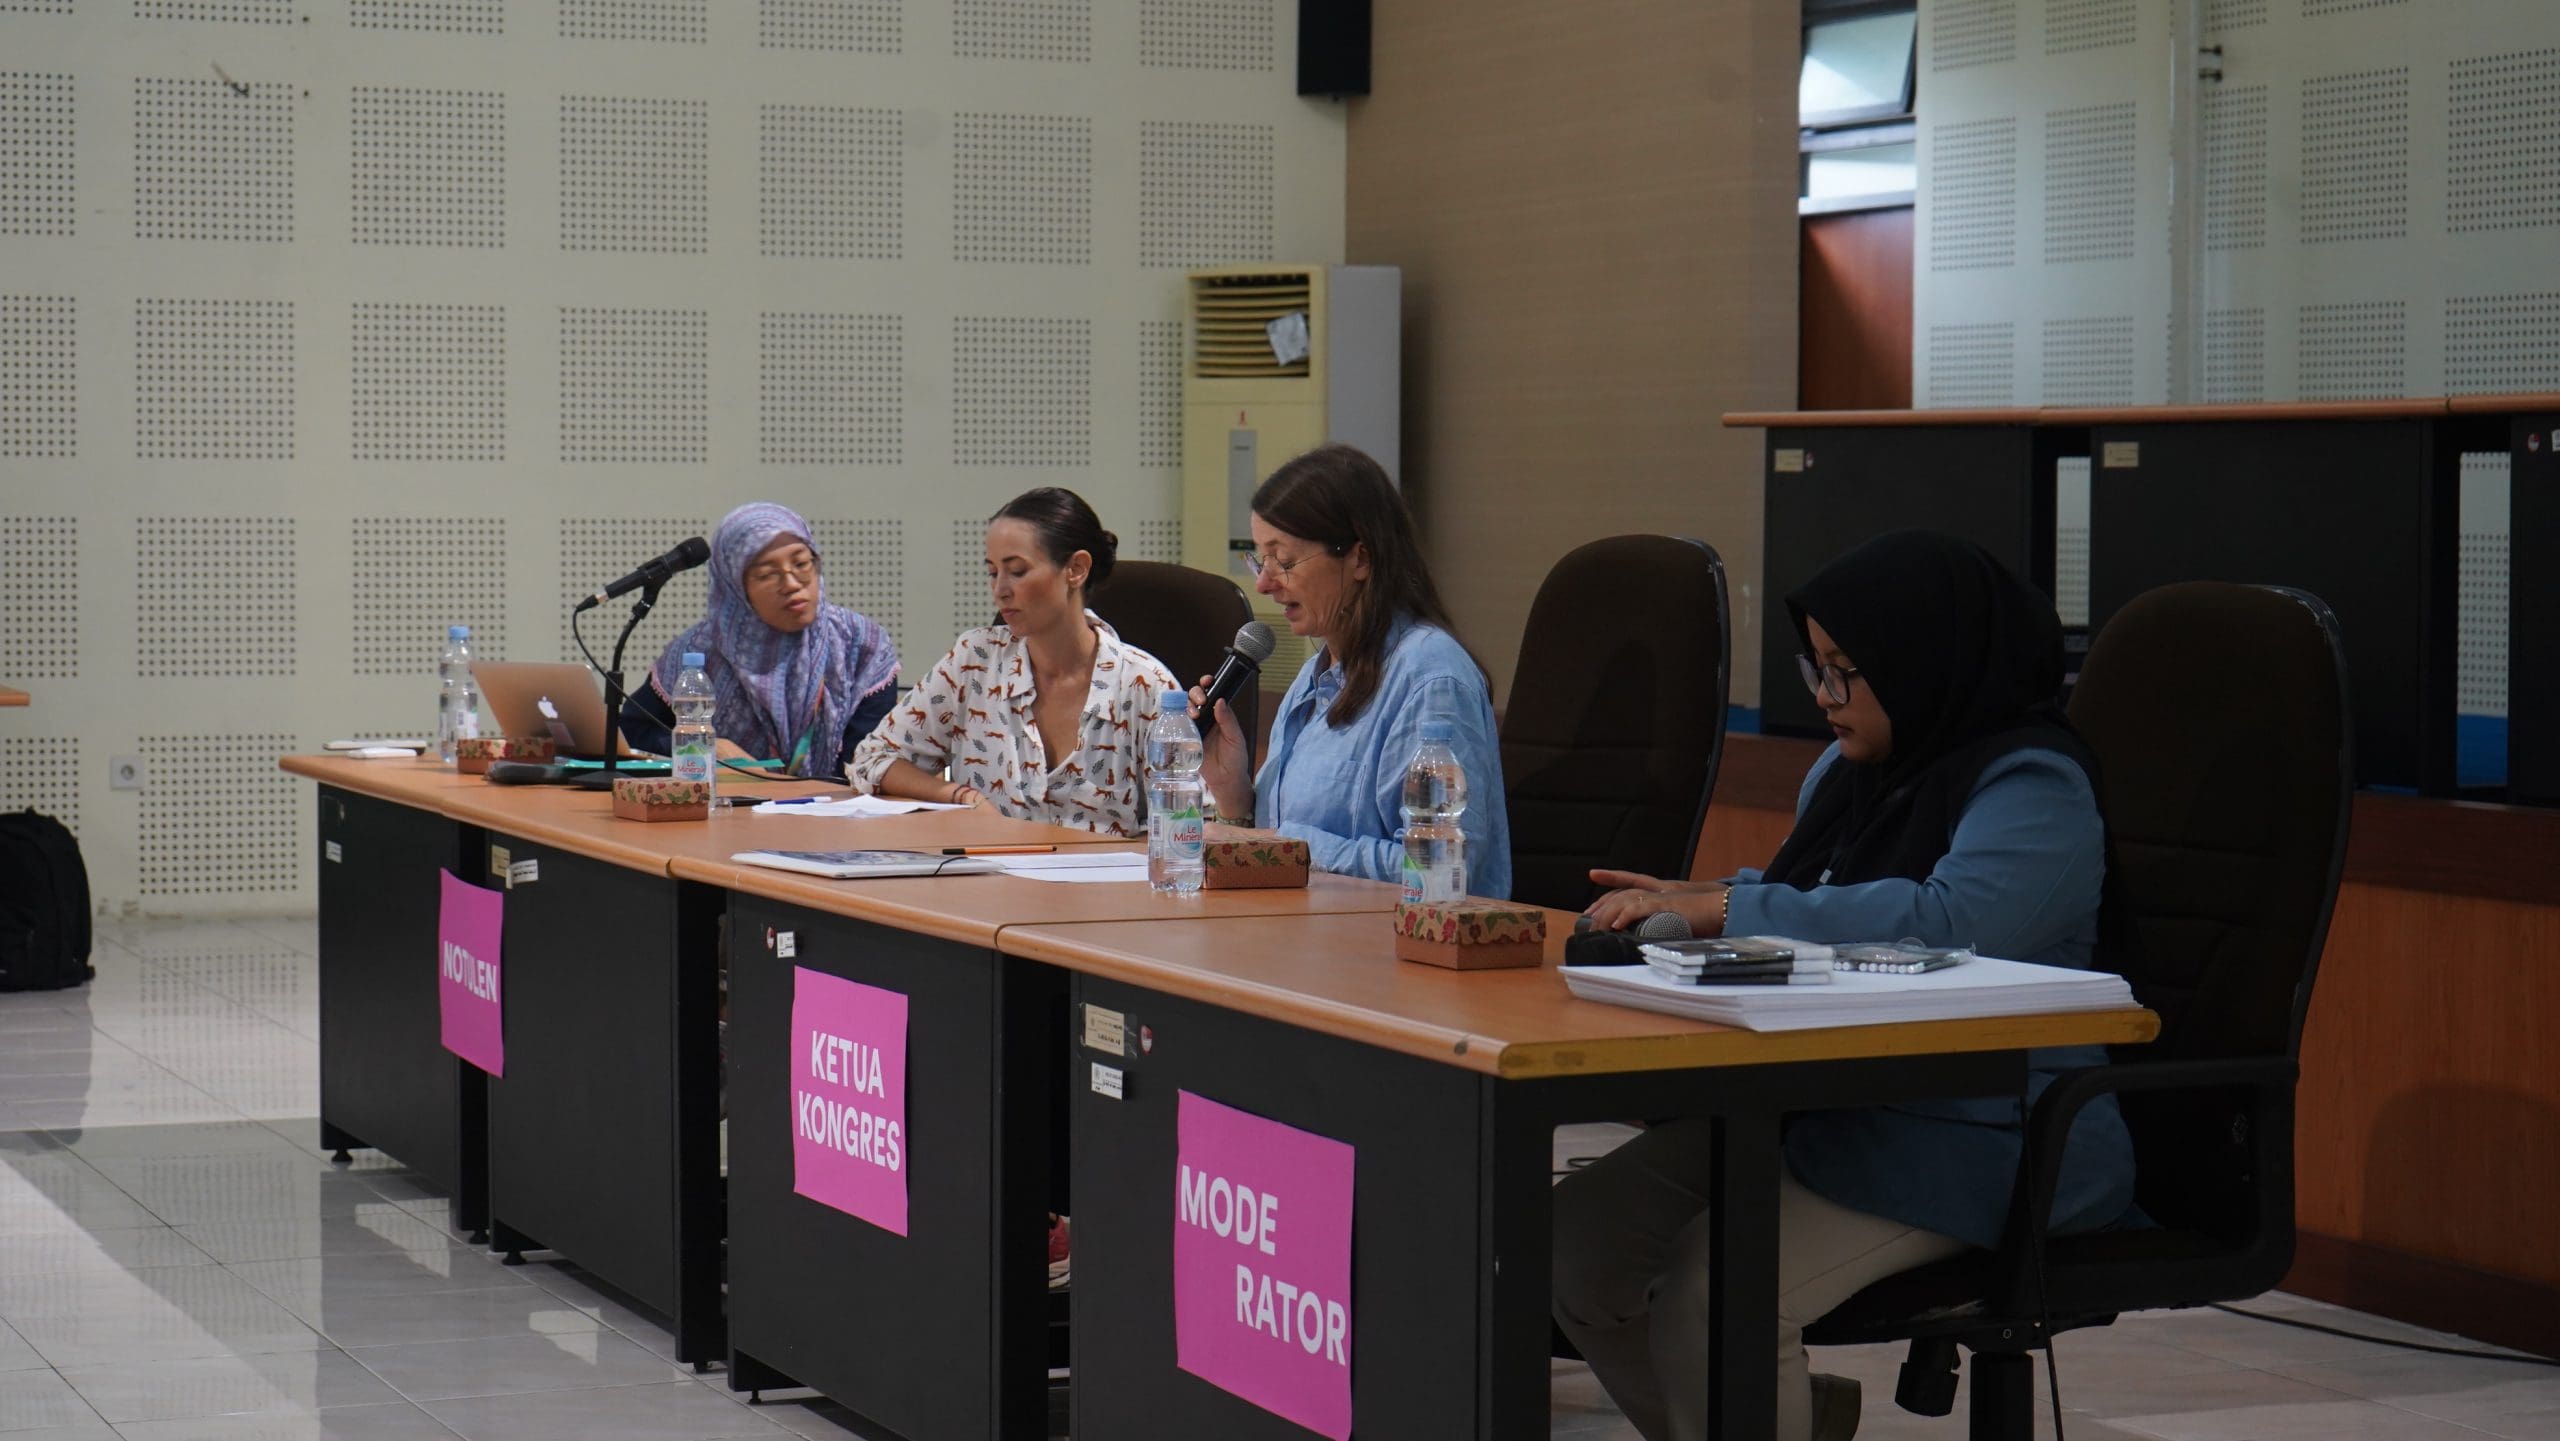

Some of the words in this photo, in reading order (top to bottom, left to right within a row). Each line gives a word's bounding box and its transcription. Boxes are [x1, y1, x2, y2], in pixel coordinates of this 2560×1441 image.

[1187, 824, 1197, 834] Le
[443, 940, 498, 1003] NOTULEN
[811, 1030, 885, 1099] KETUA
[799, 1090, 901, 1172] KONGRES
[1180, 1165, 1278, 1256] MODE
[1236, 1264, 1346, 1366] RATOR
